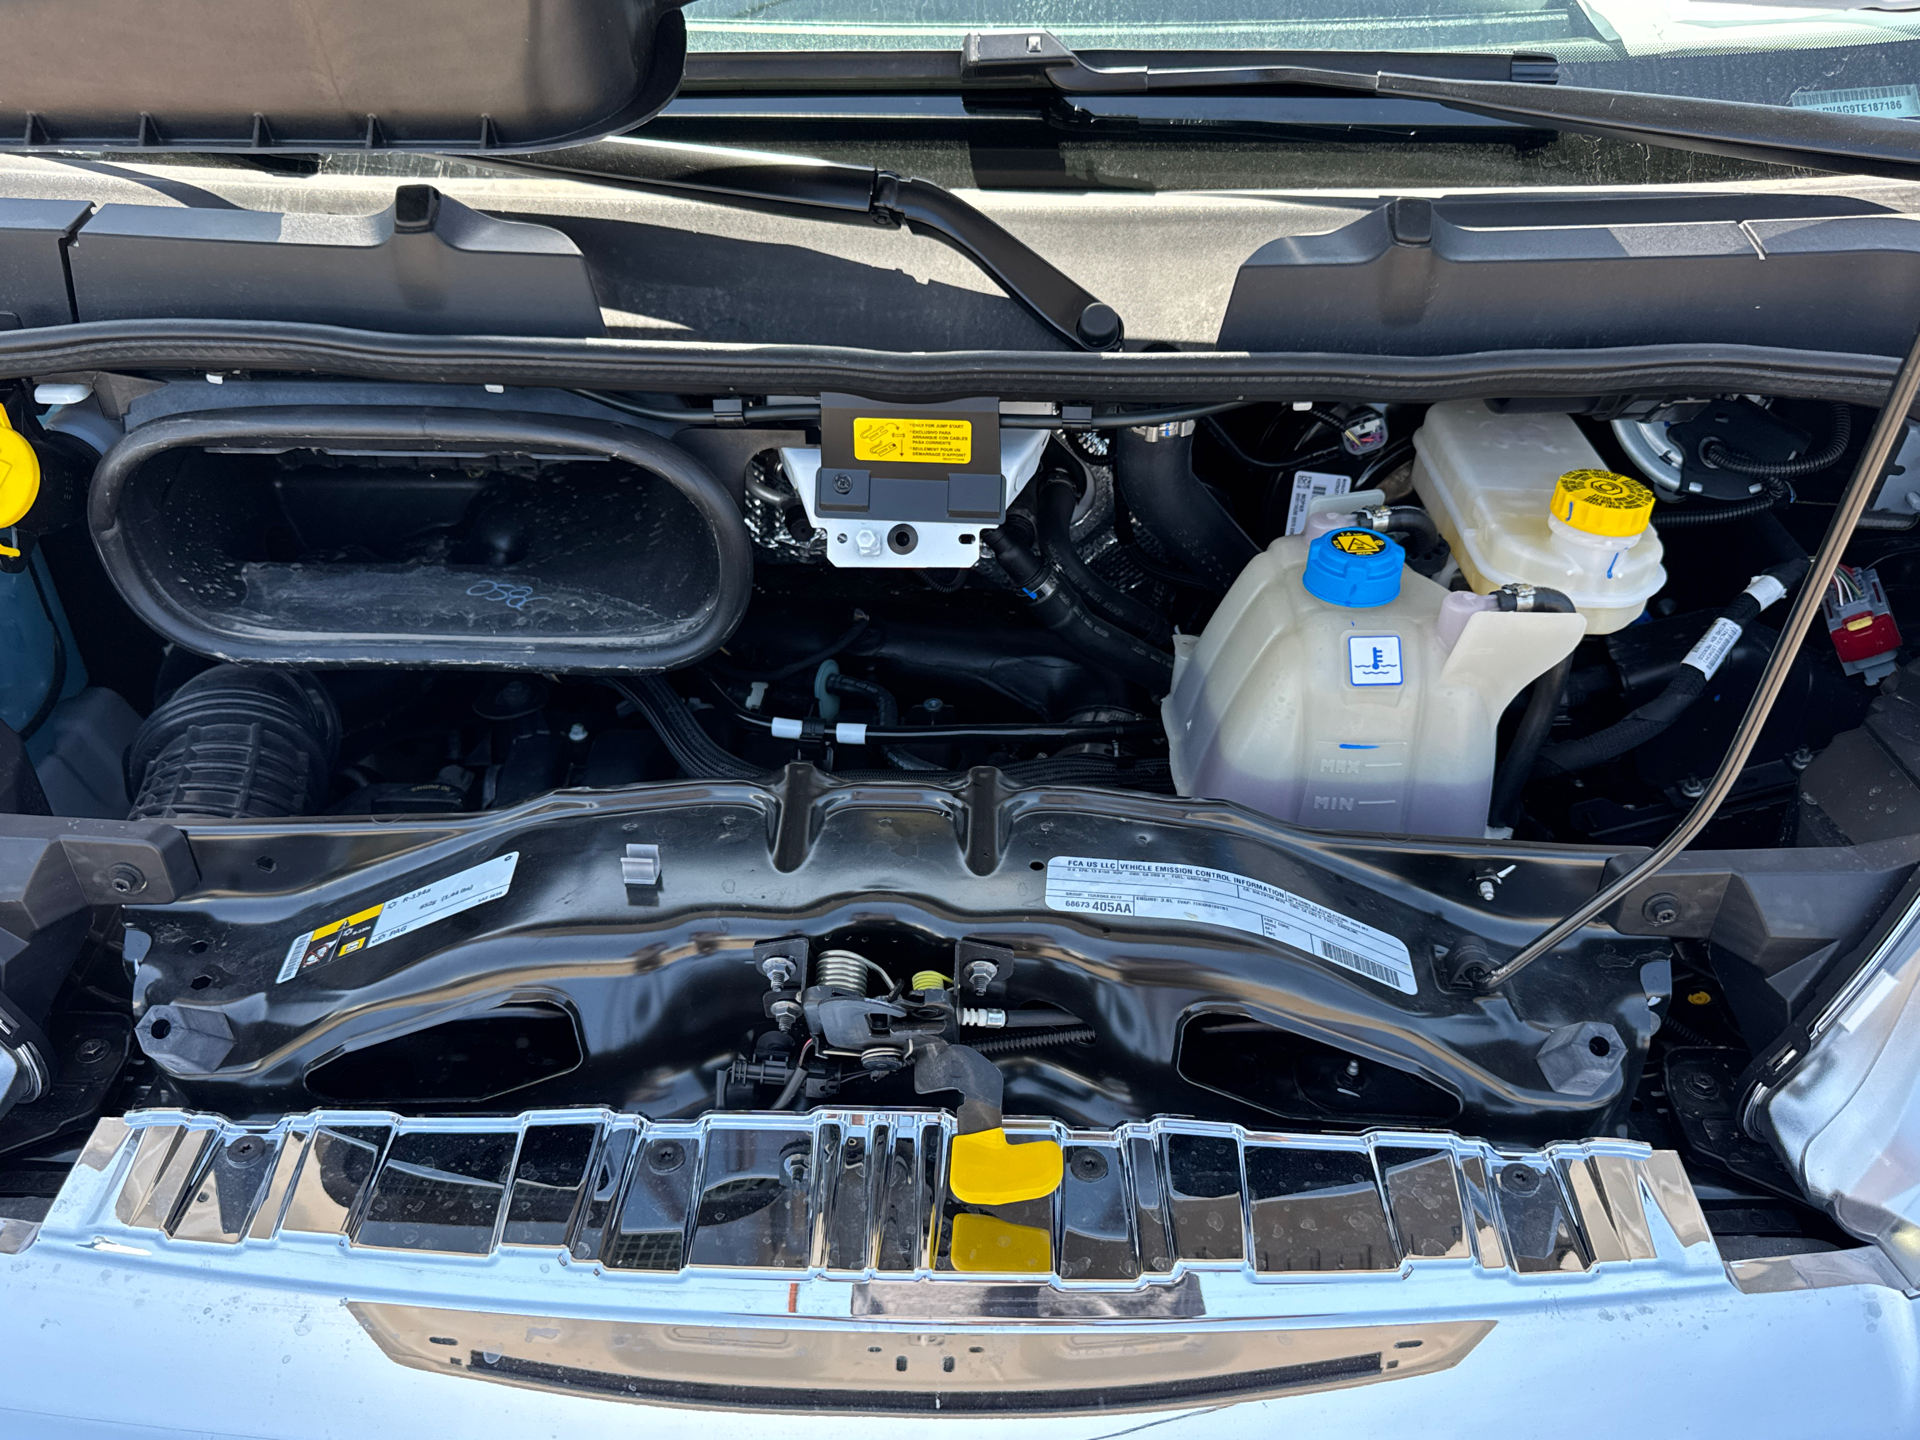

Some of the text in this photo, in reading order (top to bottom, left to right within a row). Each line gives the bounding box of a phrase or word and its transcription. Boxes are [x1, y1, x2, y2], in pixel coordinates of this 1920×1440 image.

[1319, 758, 1361, 774] MAX
[411, 784, 440, 792] ENGINE
[1313, 795, 1355, 811] MIN
[1120, 863, 1285, 898] VEHICLE EMISSION CONTROL INFORMATION
[402, 888, 431, 903] R-134a
[1065, 900, 1132, 913] 68673 405AA
[389, 925, 408, 936] PAG
